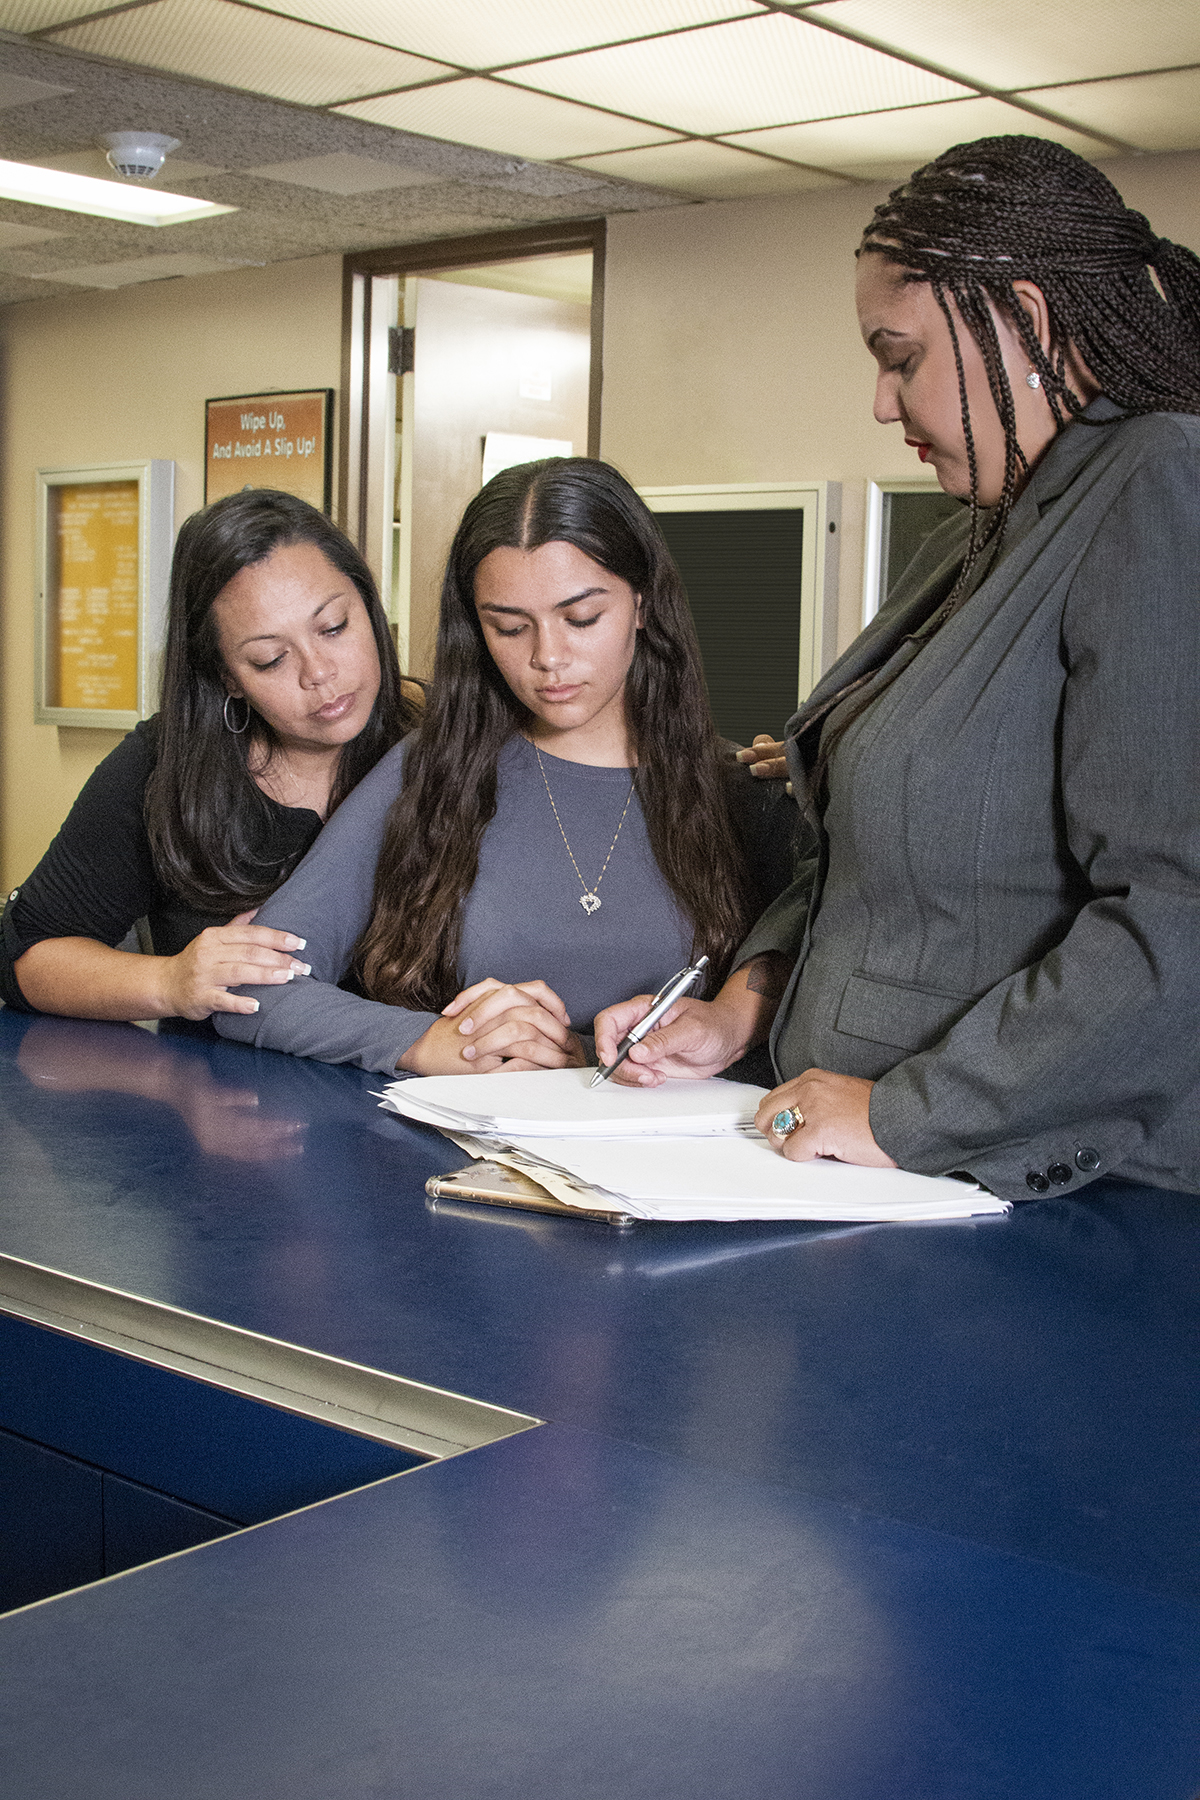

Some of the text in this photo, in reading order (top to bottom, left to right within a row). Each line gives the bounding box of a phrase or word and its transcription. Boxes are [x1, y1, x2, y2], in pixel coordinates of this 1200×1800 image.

[240, 412, 266, 433] Wipe
[213, 436, 315, 459] And Avoid A Slip Up!
